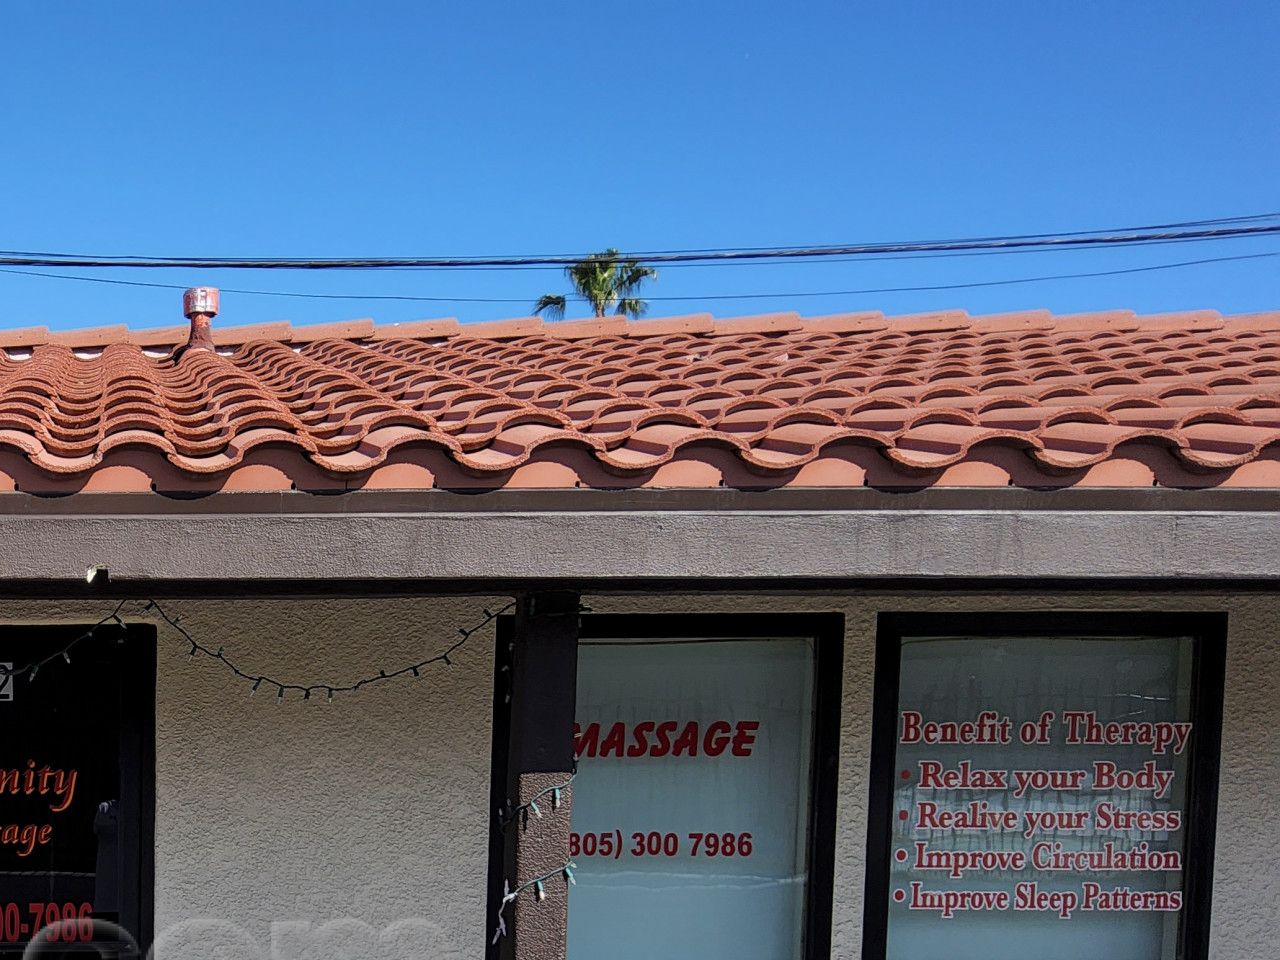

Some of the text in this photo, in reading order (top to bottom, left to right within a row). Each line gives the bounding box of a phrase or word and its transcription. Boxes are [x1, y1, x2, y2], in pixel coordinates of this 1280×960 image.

[899, 711, 1192, 754] Benefit of Therapy
[918, 760, 1174, 799] Relax your Body
[917, 801, 1181, 838] Realive your Stress
[570, 829, 753, 860] 805) 300 7986
[913, 841, 1182, 878] Improve Circulation
[909, 881, 1182, 919] Improve Sleep Patterns
